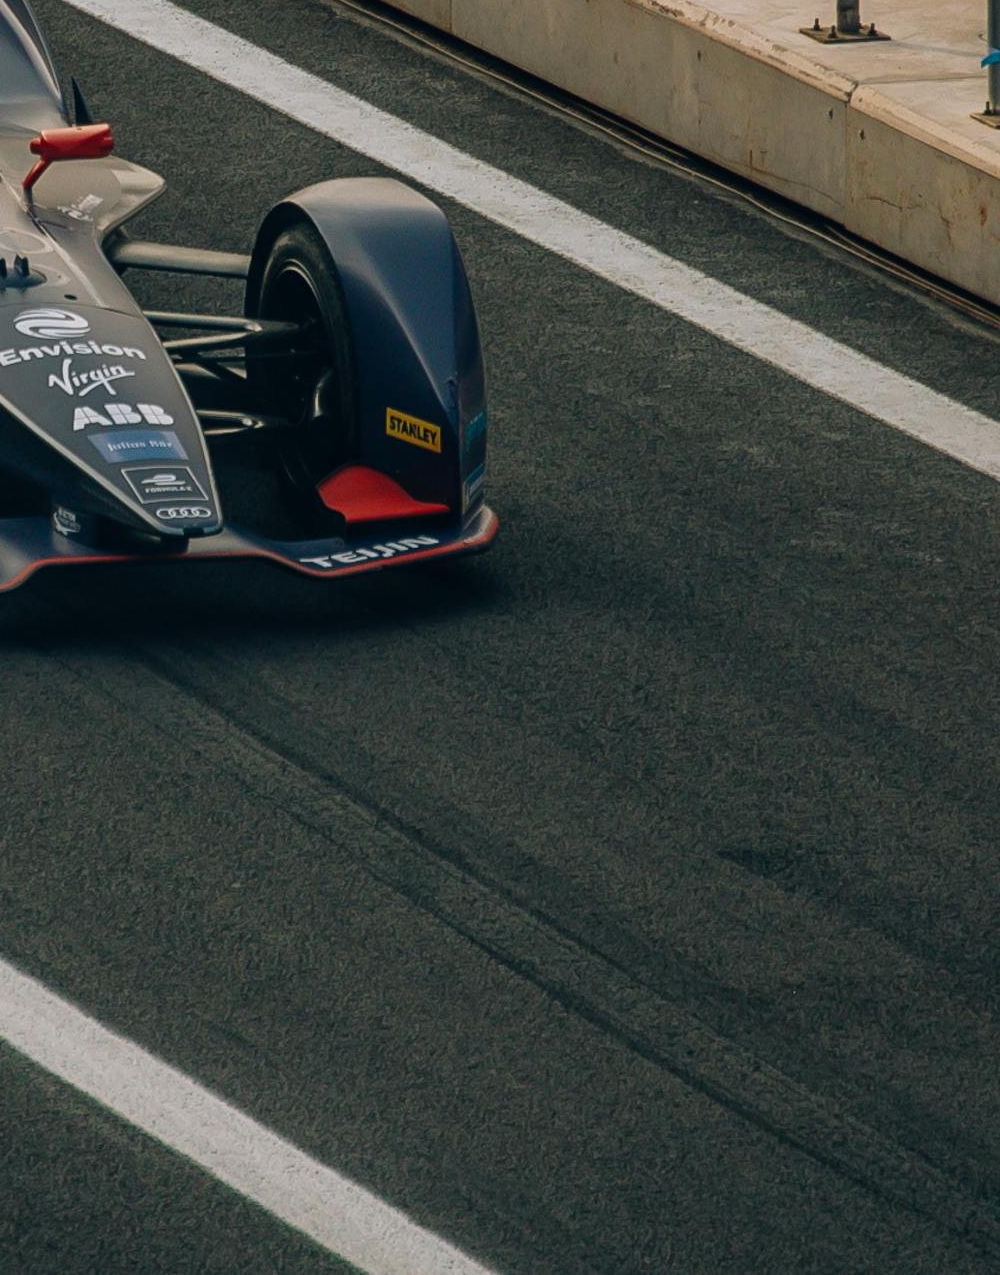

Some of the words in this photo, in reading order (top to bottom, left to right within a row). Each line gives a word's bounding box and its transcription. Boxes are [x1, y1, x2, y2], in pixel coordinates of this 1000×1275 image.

[47, 358, 135, 397] Virgin
[72, 403, 174, 431] ABB
[388, 415, 438, 447] STANLEY
[300, 534, 440, 569] TEIJIN
